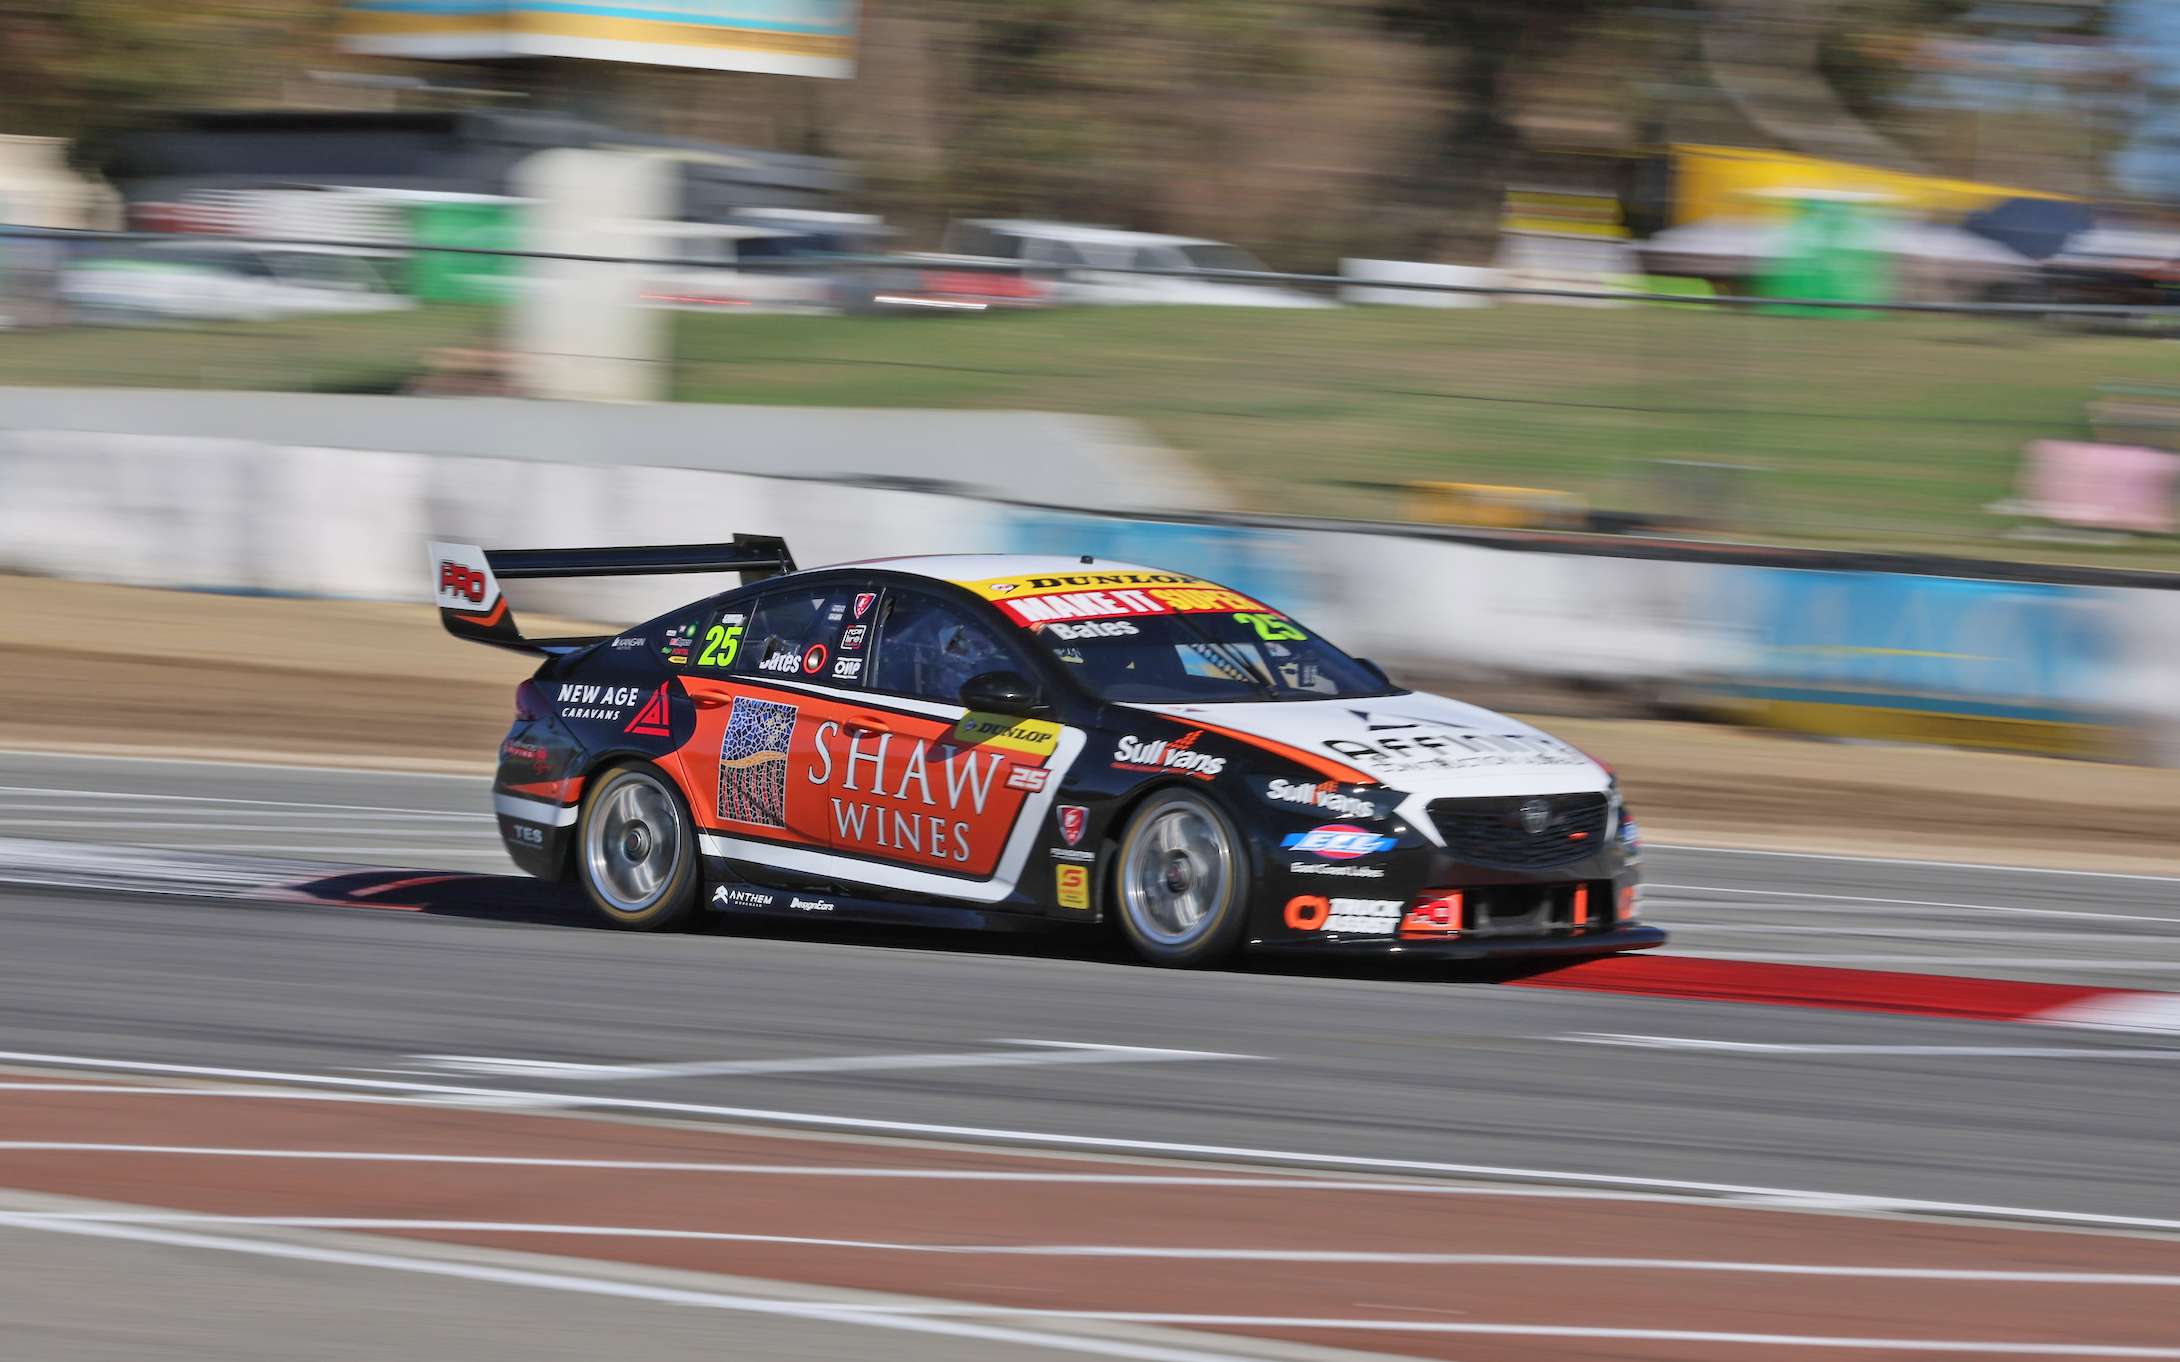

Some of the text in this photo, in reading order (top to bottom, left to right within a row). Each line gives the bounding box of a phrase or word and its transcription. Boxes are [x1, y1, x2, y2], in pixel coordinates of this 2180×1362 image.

[440, 560, 485, 604] PRO
[1027, 574, 1202, 589] DUNLOP
[1006, 588, 1268, 622] MAKE IT SUPER
[1047, 620, 1140, 641] Bates
[1232, 612, 1308, 641] 25
[697, 625, 744, 667] 25
[834, 660, 861, 676] OMP
[558, 684, 639, 707] NEW AGE
[561, 707, 621, 721] CARAVANS
[977, 721, 1052, 744] DUNLOP
[1114, 734, 1228, 775] Sullivans
[807, 720, 1006, 815] SHAW
[1007, 767, 1048, 790] 25
[830, 797, 970, 862] WINES
[729, 890, 774, 905] ANTHEM
